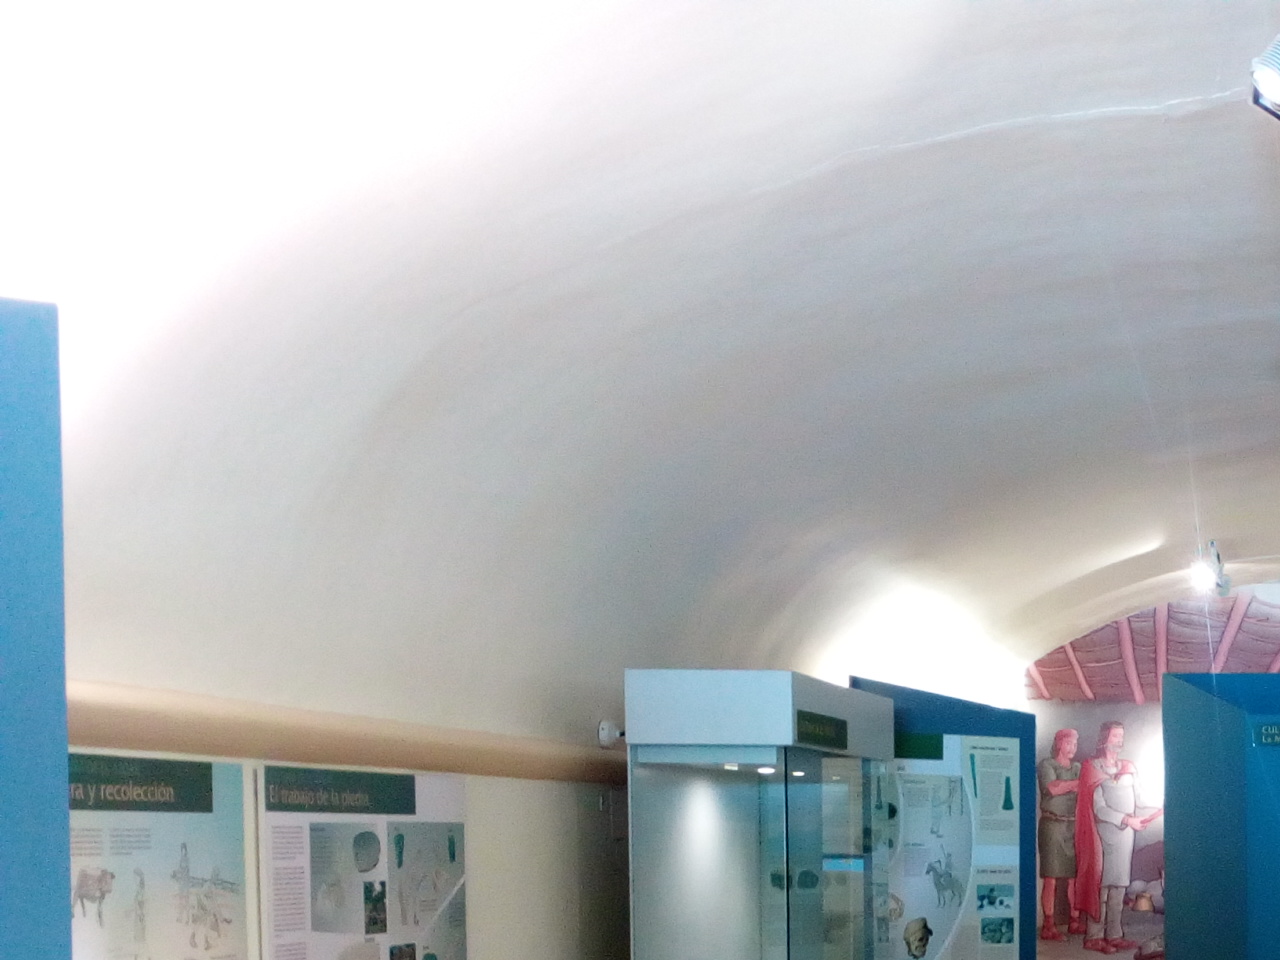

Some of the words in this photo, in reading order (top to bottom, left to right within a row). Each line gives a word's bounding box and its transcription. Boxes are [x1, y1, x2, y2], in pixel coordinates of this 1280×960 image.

[1262, 735, 1272, 744] La
[87, 783, 96, 806] y
[100, 780, 175, 803] recolección
